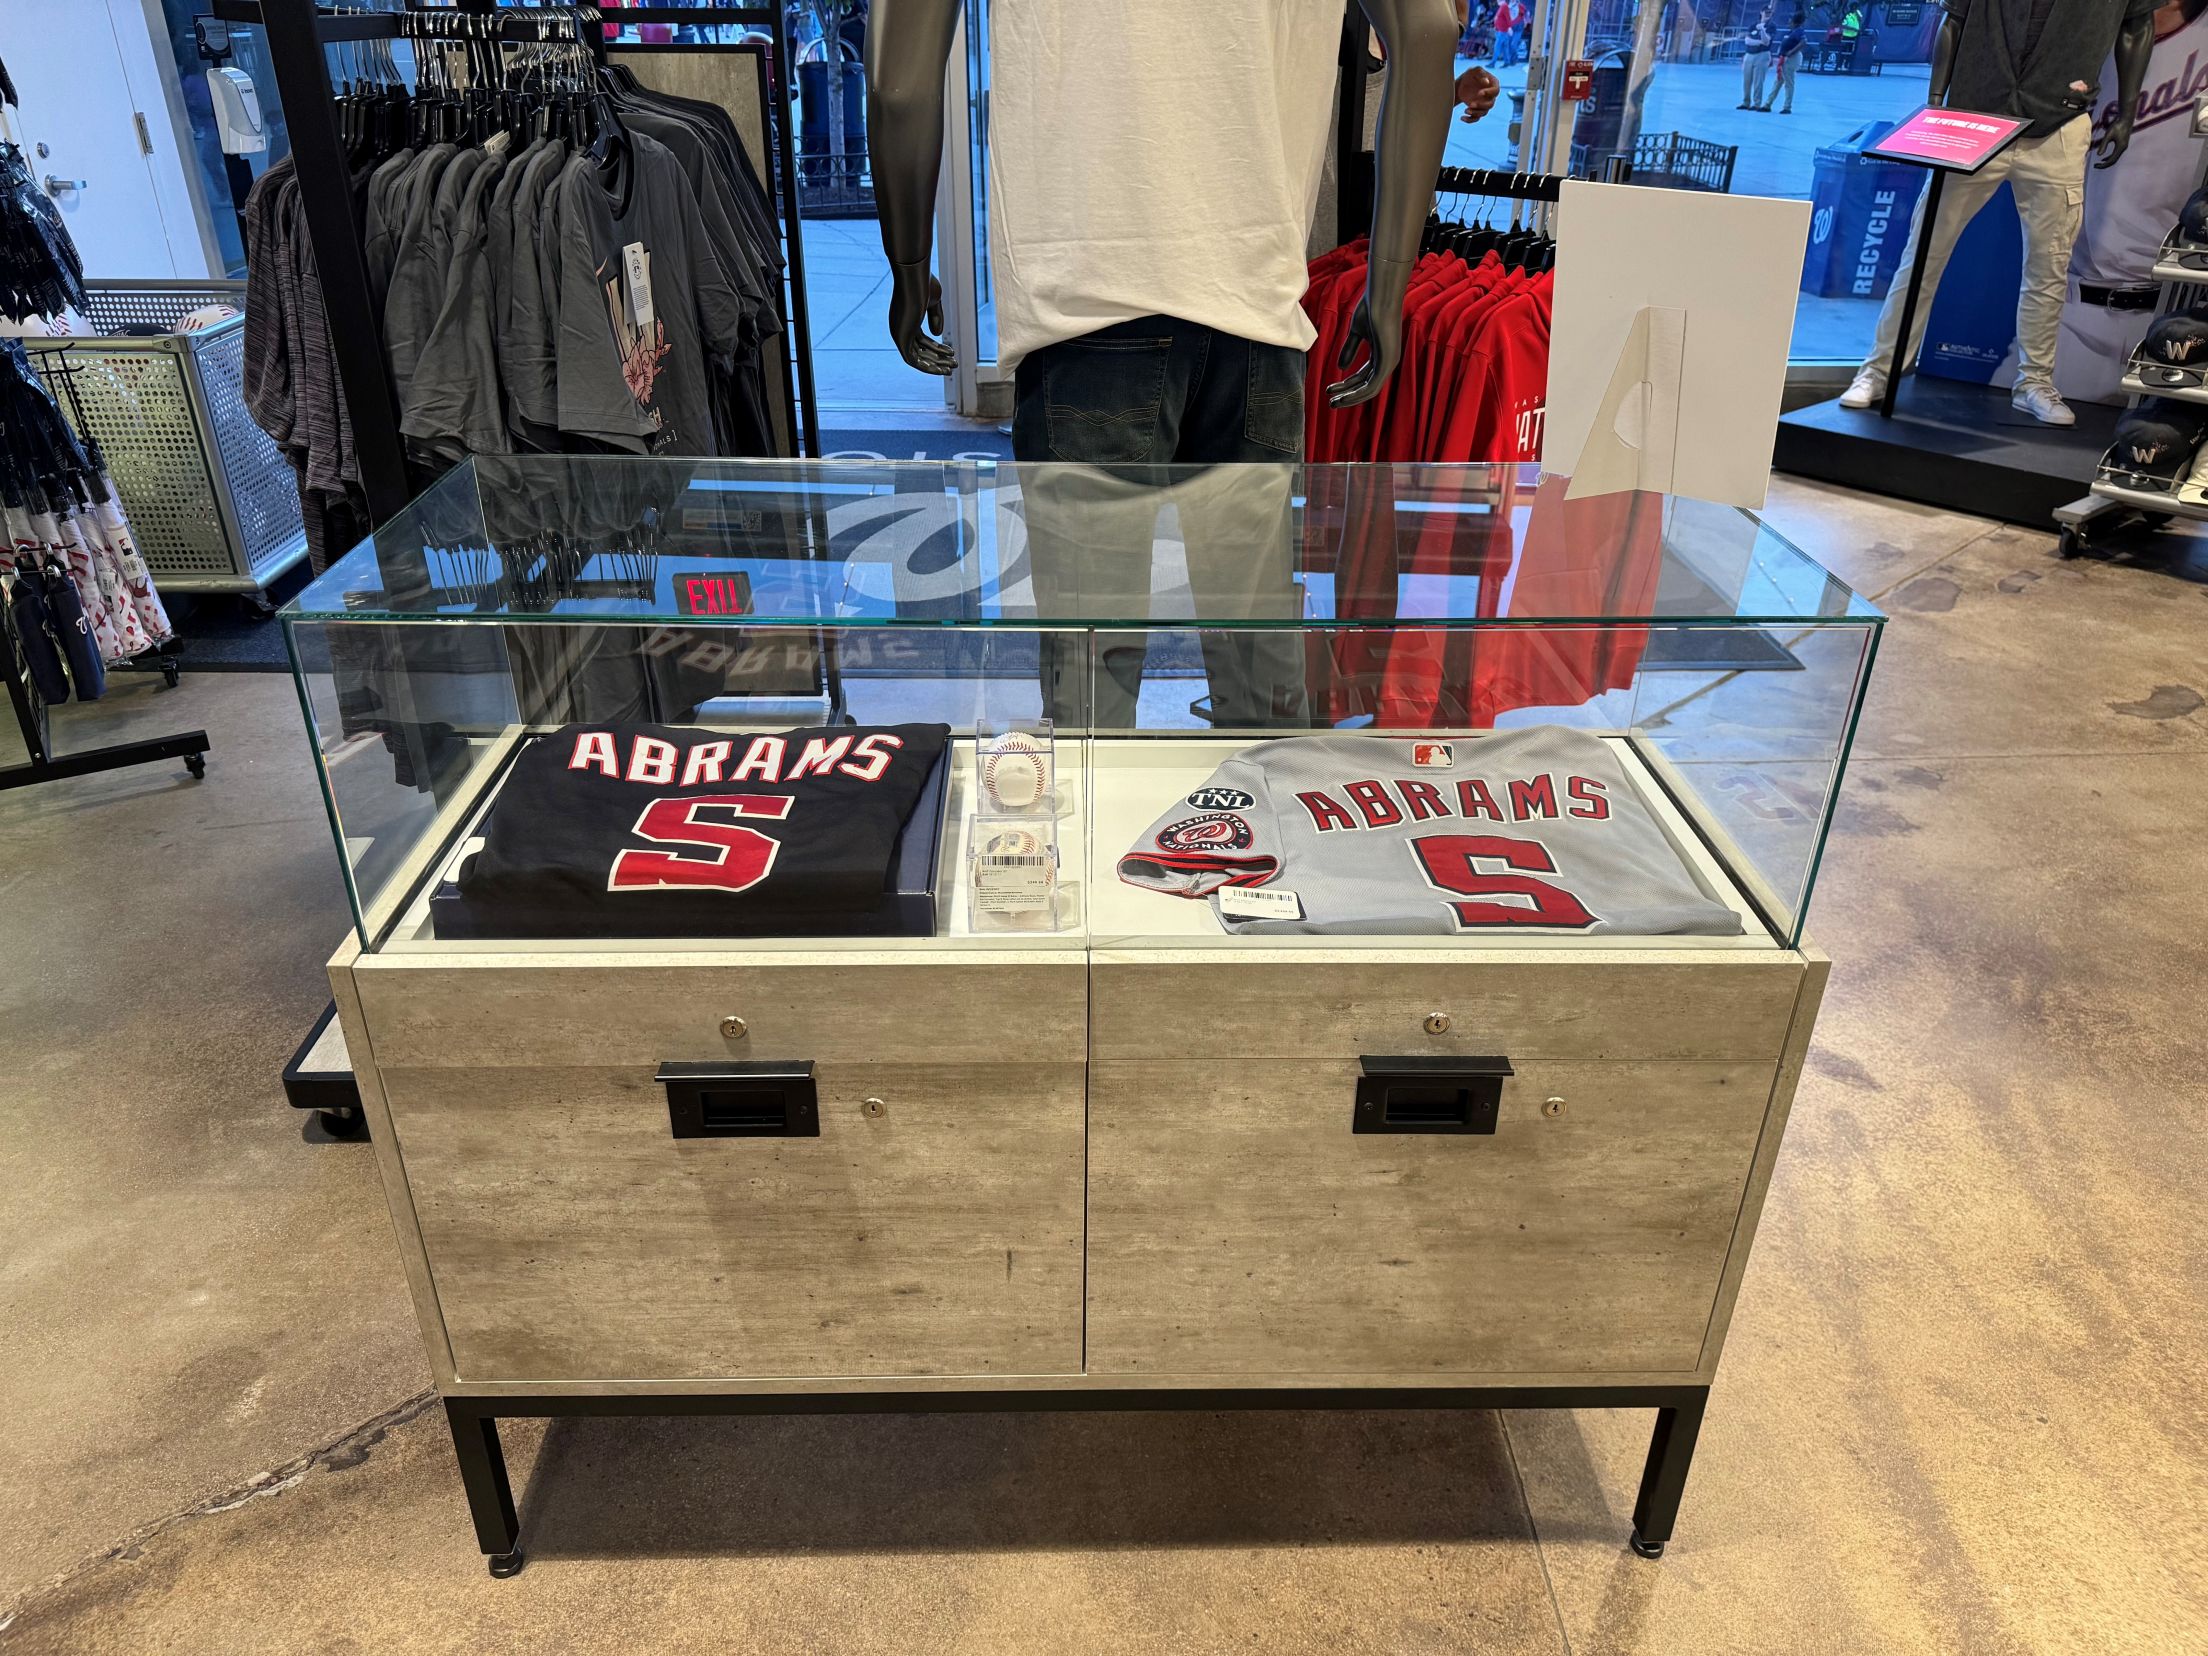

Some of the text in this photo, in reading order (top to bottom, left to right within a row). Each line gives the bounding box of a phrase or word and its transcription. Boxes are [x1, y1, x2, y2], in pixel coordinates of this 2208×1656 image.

[1852, 190, 1896, 294] RECYCLE
[2165, 339, 2191, 361] W
[2131, 445, 2157, 465] W
[568, 732, 904, 787] ABRAMS
[1191, 793, 1250, 809] TNL
[1292, 771, 1613, 834] ABRAMS
[607, 794, 795, 892] 5
[1166, 813, 1249, 836] WASHINGTON
[1162, 839, 1238, 851] NATIONALS
[1404, 834, 1608, 934] 5
